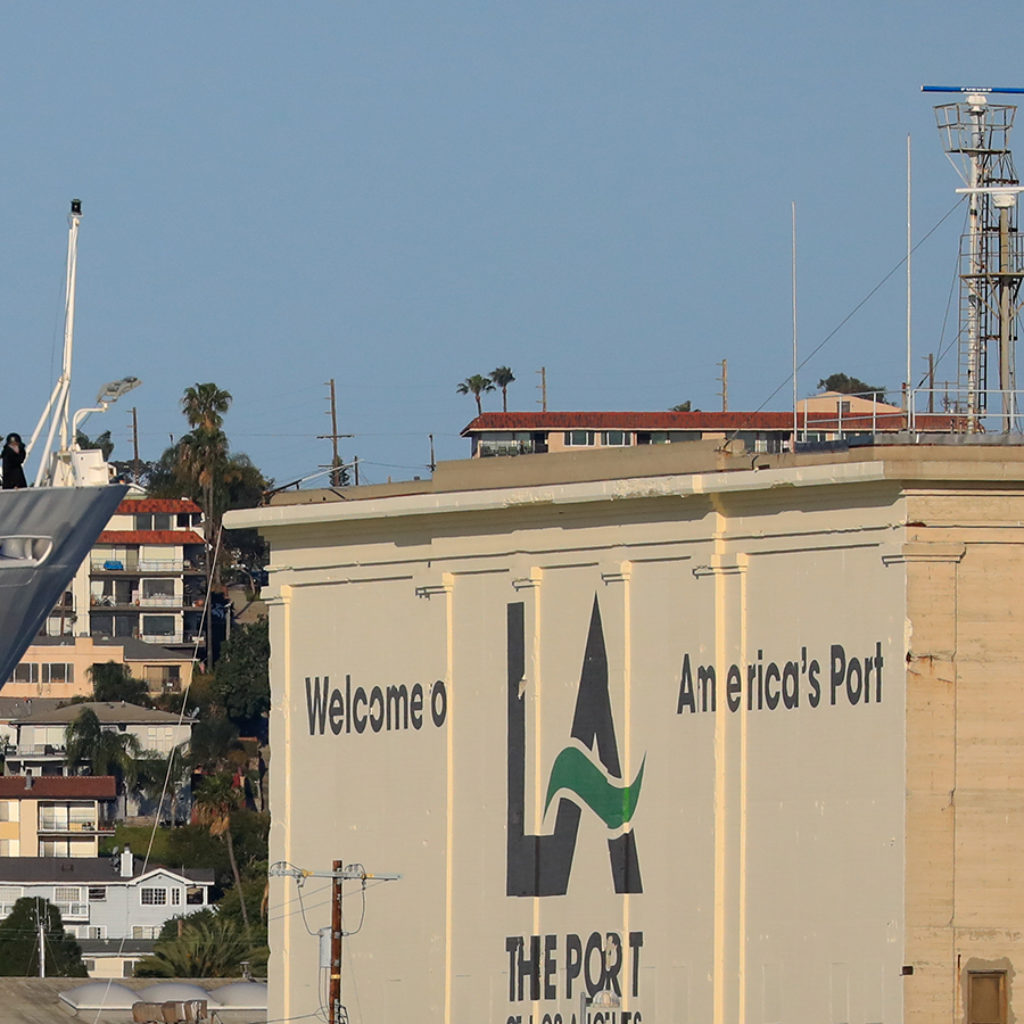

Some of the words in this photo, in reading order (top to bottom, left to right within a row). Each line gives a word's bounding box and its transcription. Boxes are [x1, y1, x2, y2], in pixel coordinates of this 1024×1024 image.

[304, 674, 424, 736] Welcome
[676, 646, 821, 715] America's
[830, 641, 884, 706] Port
[506, 589, 644, 898] LA
[505, 934, 557, 1002] THE
[566, 931, 643, 999] PORT
